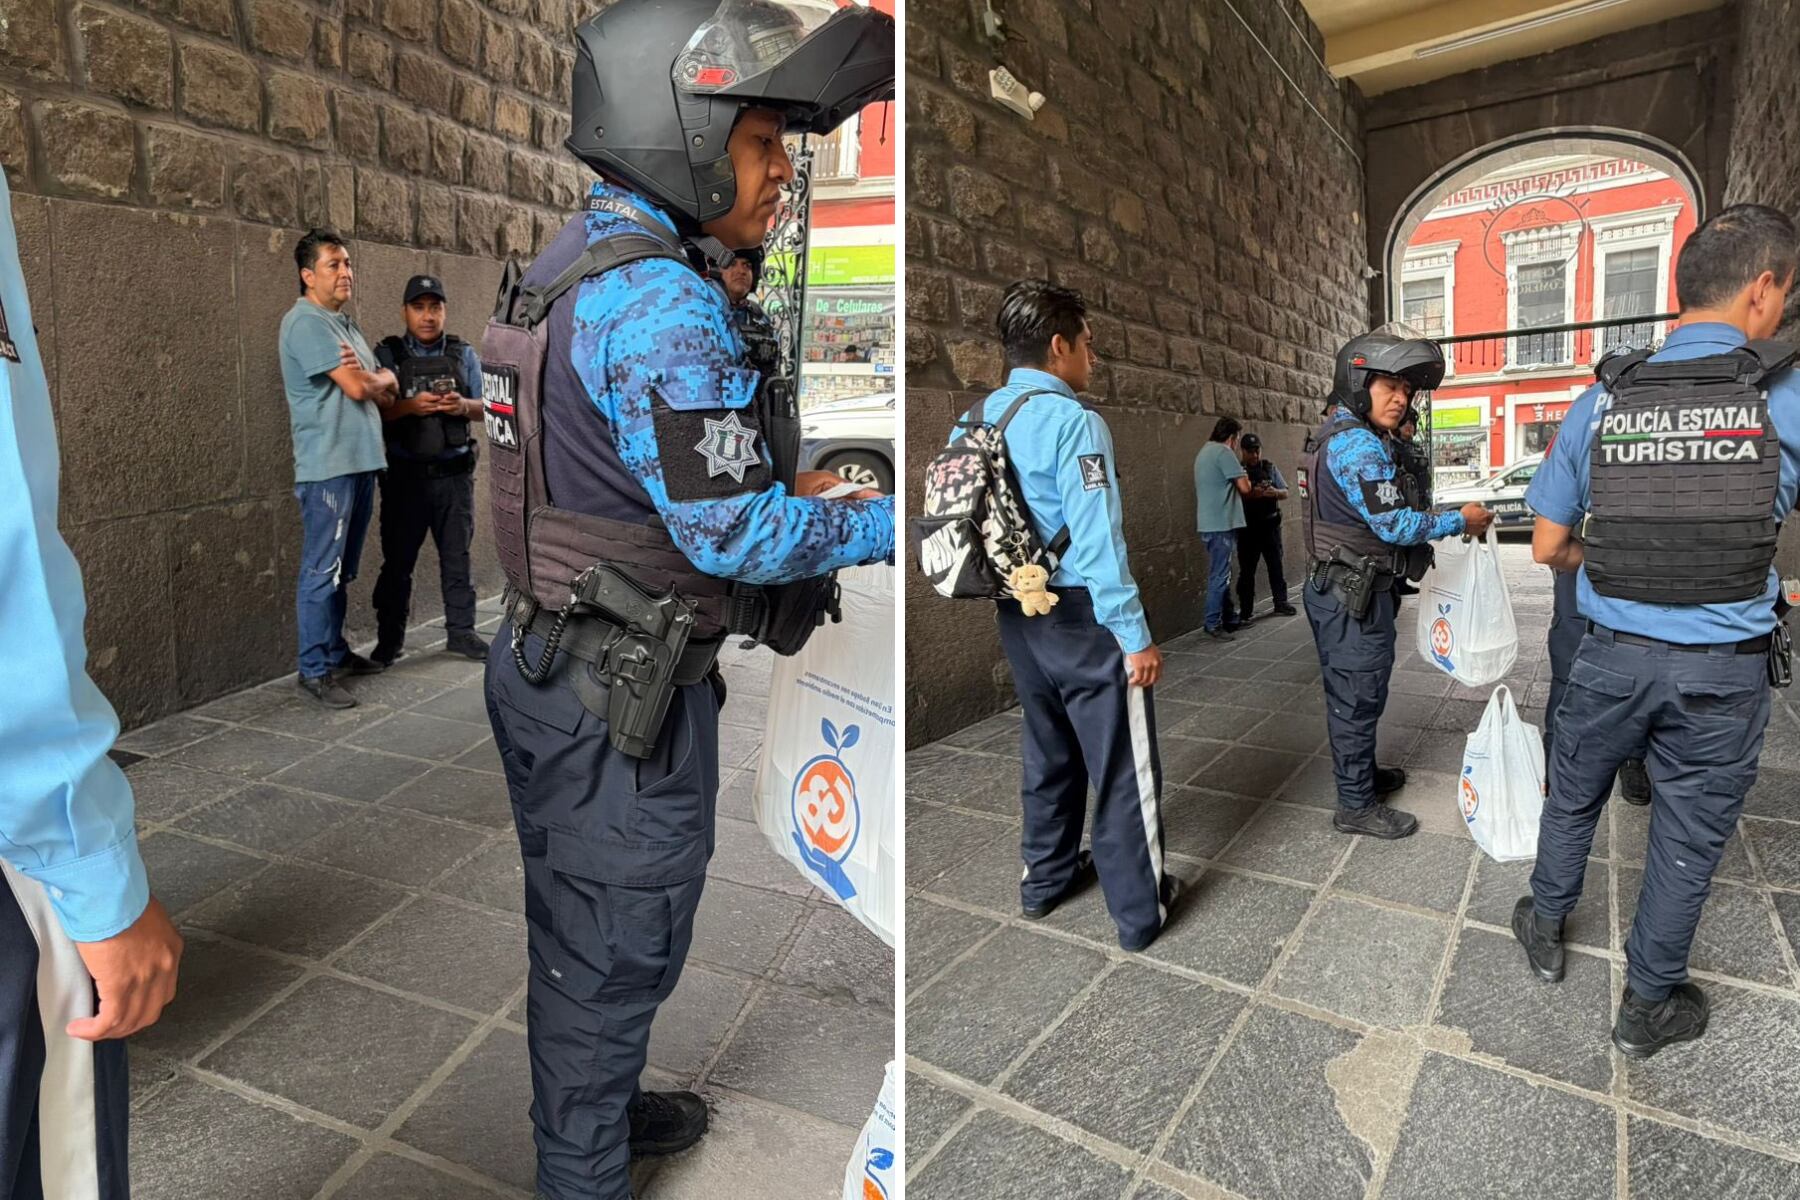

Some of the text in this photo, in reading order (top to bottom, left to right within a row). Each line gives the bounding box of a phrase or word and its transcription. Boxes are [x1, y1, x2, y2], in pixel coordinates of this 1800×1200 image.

[591, 199, 640, 221] ESTATAL
[816, 298, 883, 313] De Celulares
[1602, 406, 1762, 435] POLICÍA ESTATAL
[1601, 438, 1759, 463] TURÍSTICA
[1493, 501, 1522, 513] POLICÍA
[922, 519, 962, 576] NIKE
